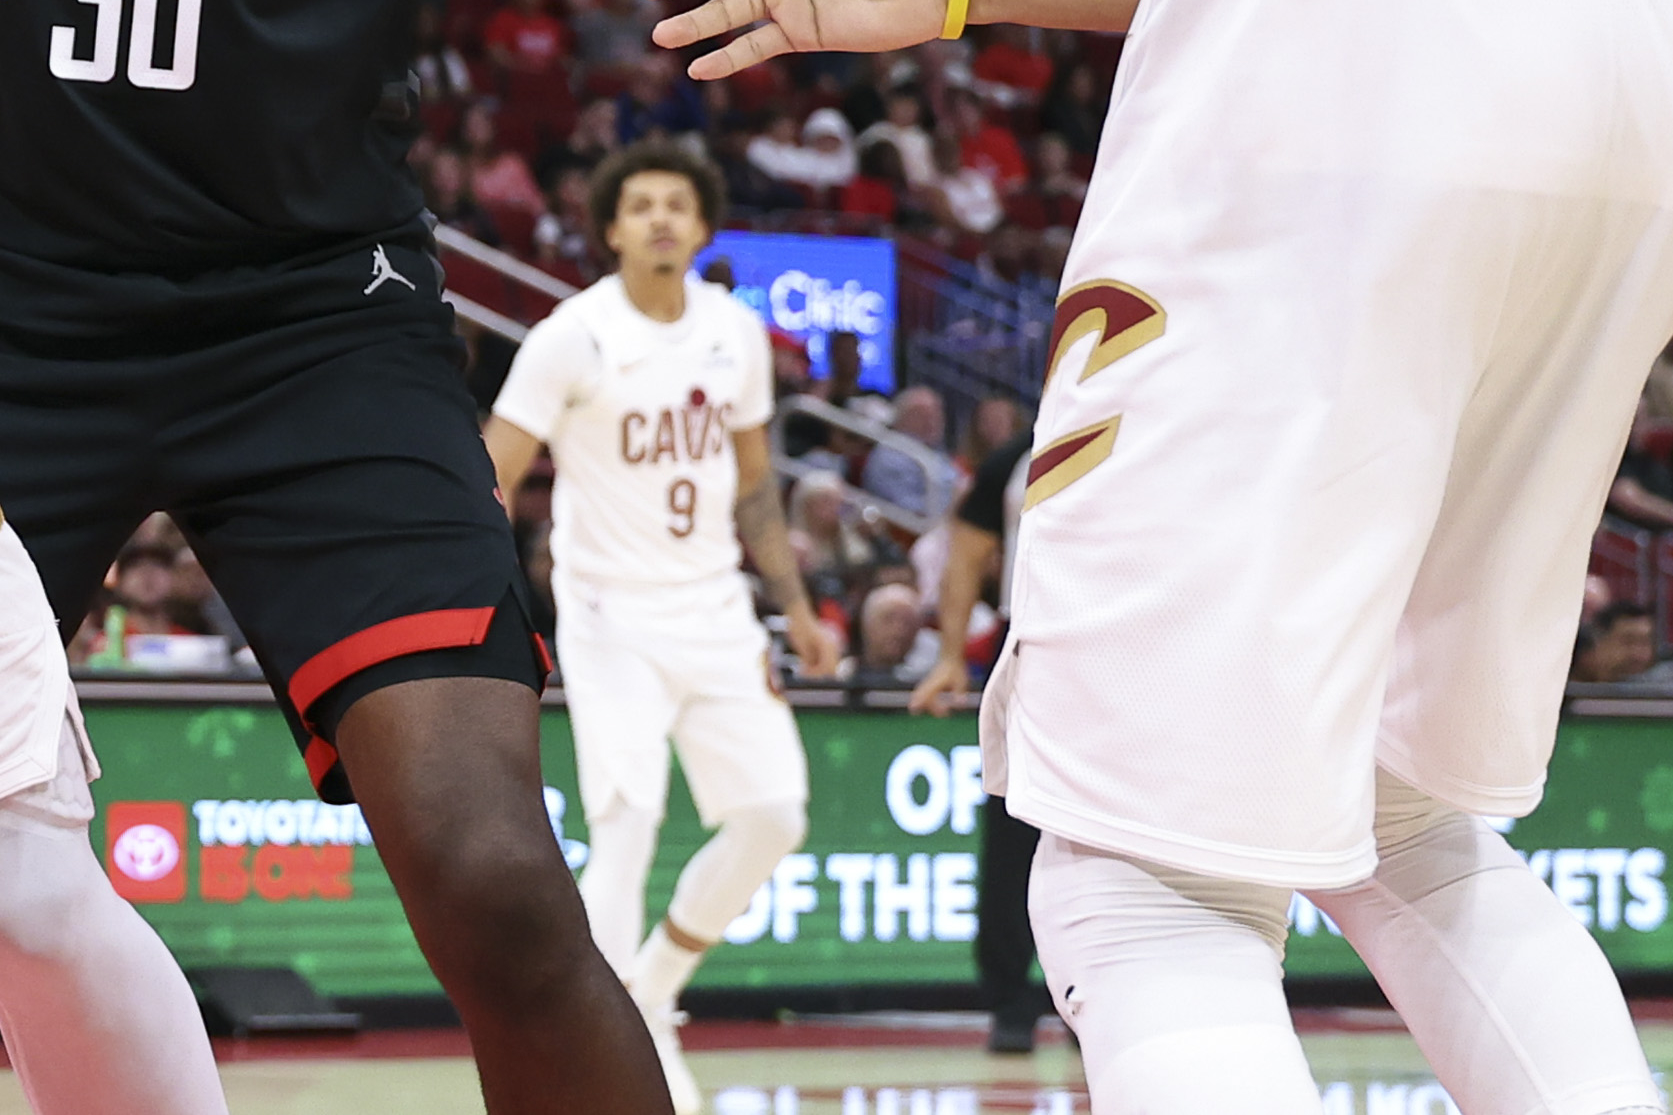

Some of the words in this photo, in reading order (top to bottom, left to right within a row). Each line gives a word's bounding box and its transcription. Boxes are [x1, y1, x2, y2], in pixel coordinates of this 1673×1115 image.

[769, 269, 887, 336] Clinic
[620, 400, 732, 465] CAVS
[667, 478, 698, 538] 9
[825, 852, 980, 944] THE
